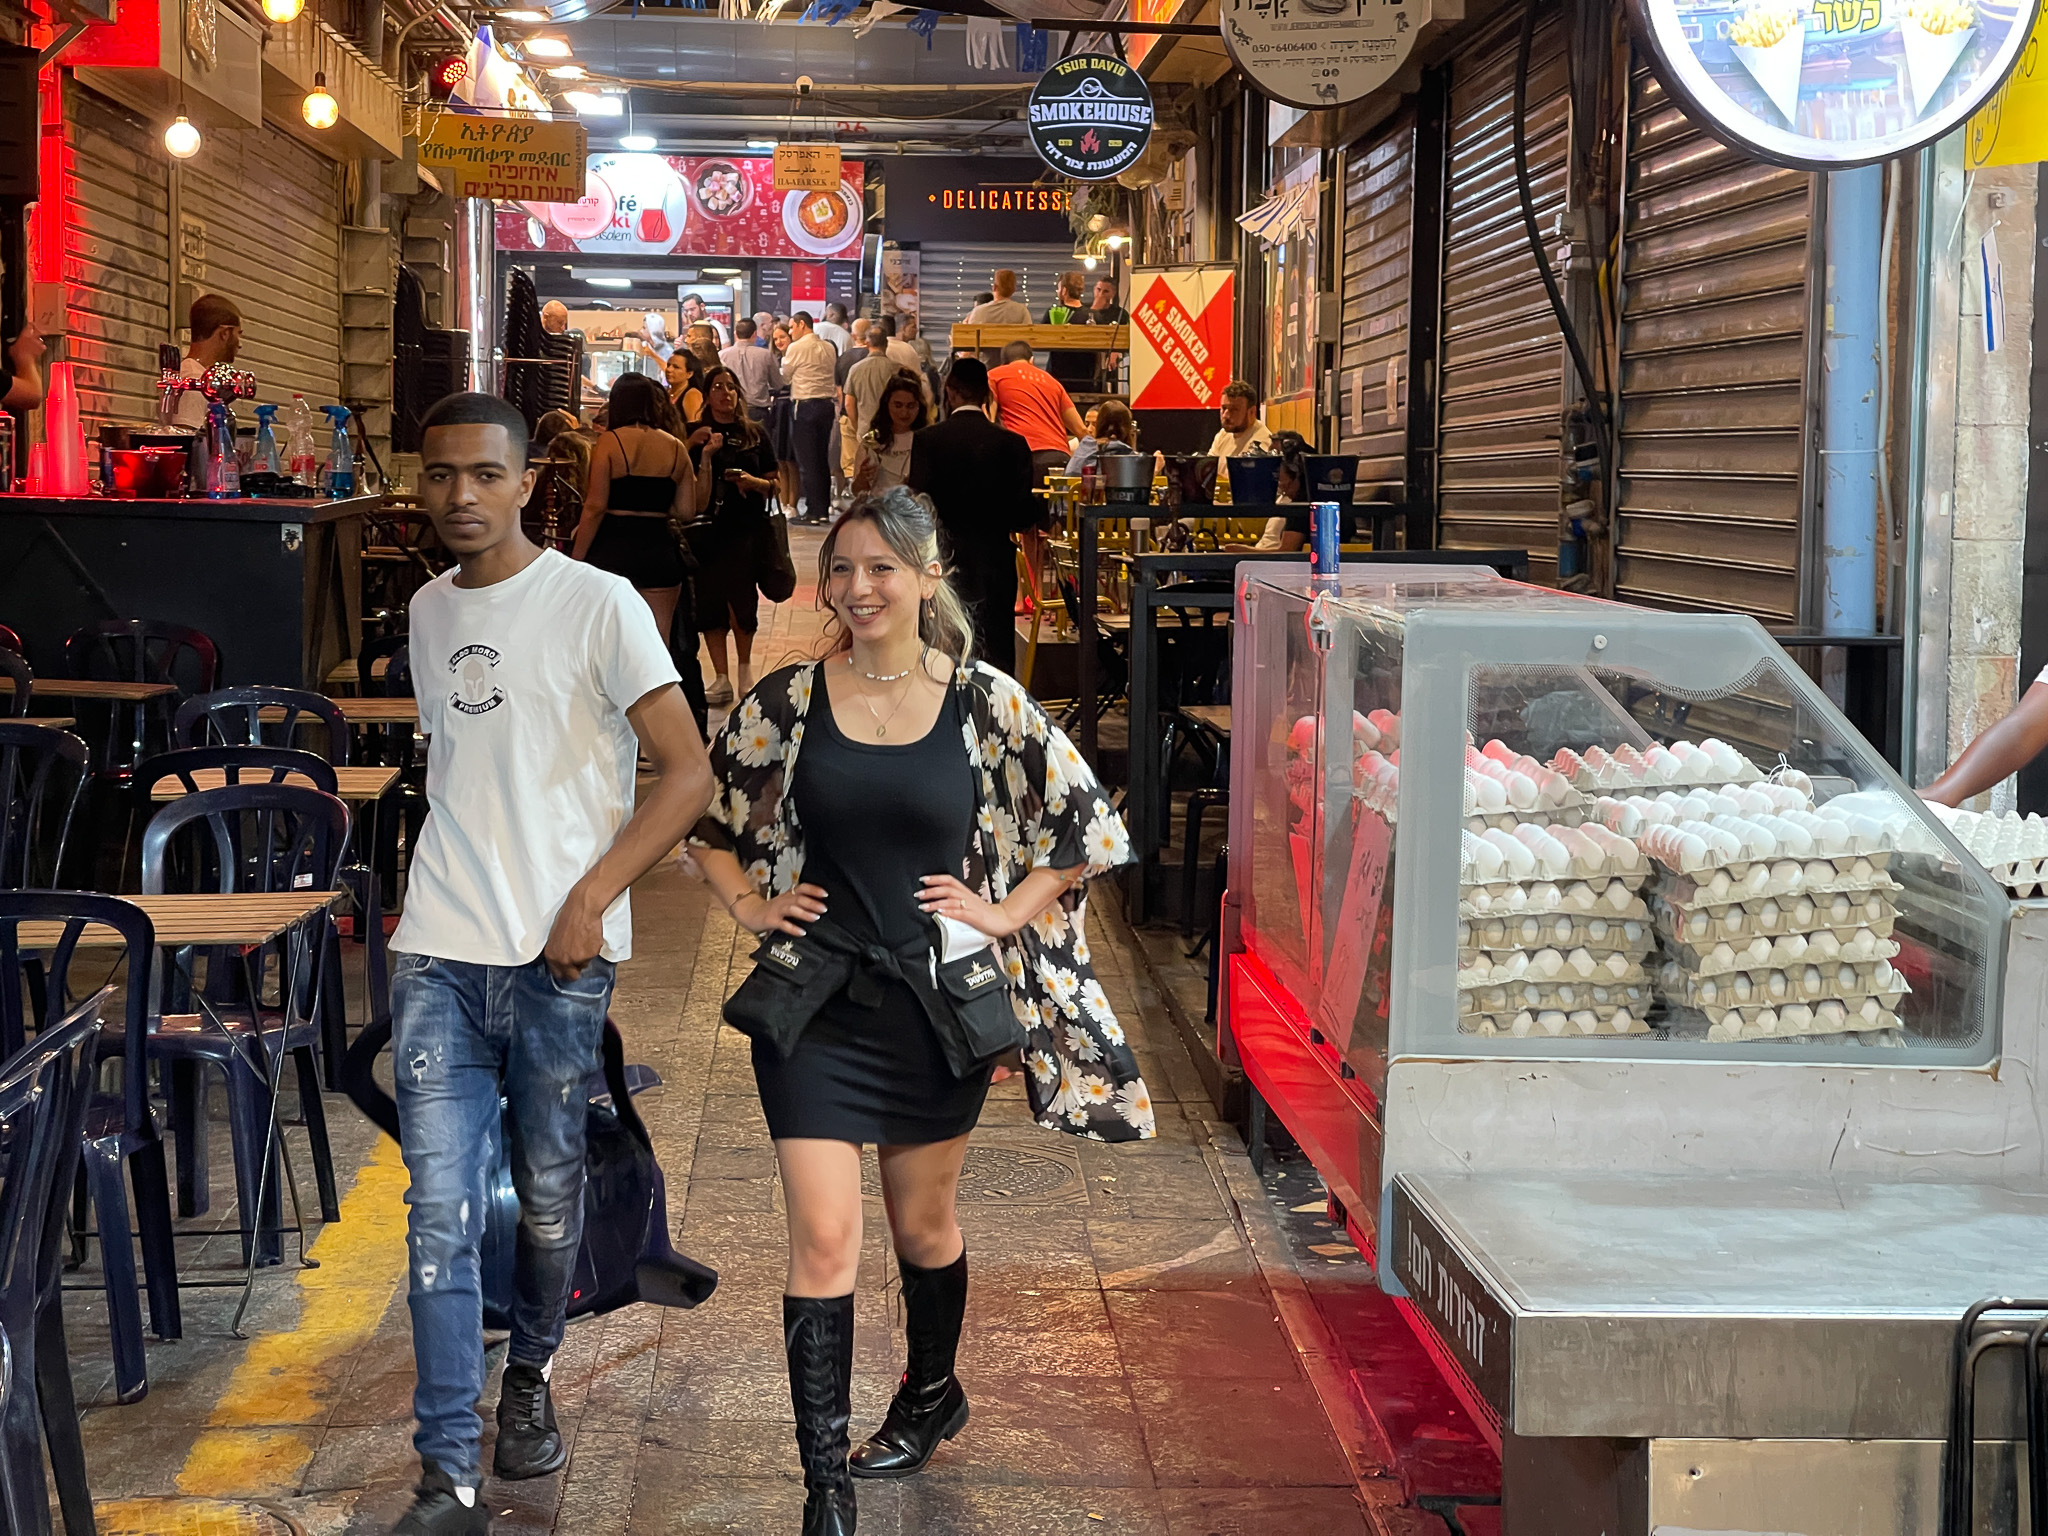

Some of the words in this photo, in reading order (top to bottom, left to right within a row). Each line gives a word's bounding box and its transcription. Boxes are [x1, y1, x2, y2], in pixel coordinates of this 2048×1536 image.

[1813, 0, 1881, 34] כשר
[1252, 42, 1317, 54] 050-6406400
[1055, 58, 1087, 76] TSUR
[1090, 58, 1127, 77] DAVID
[1029, 102, 1152, 124] SMOKEHOUSE
[779, 150, 820, 160] האפרסק
[1045, 140, 1063, 159] דוד
[1064, 155, 1084, 170] צור
[489, 164, 558, 182] איתיופיה
[464, 181, 532, 200] תבלינים
[538, 185, 575, 201] חנות
[613, 213, 630, 228] ki
[1165, 306, 1209, 365] SMOKED
[1138, 302, 1168, 343] MEAT
[1162, 336, 1175, 354] &
[1169, 347, 1212, 405] CHICKEN
[471, 646, 496, 659] MORO
[458, 698, 497, 714] PREMIUM
[1408, 1219, 1432, 1299] חם!
[1437, 1261, 1485, 1368] זהירות
